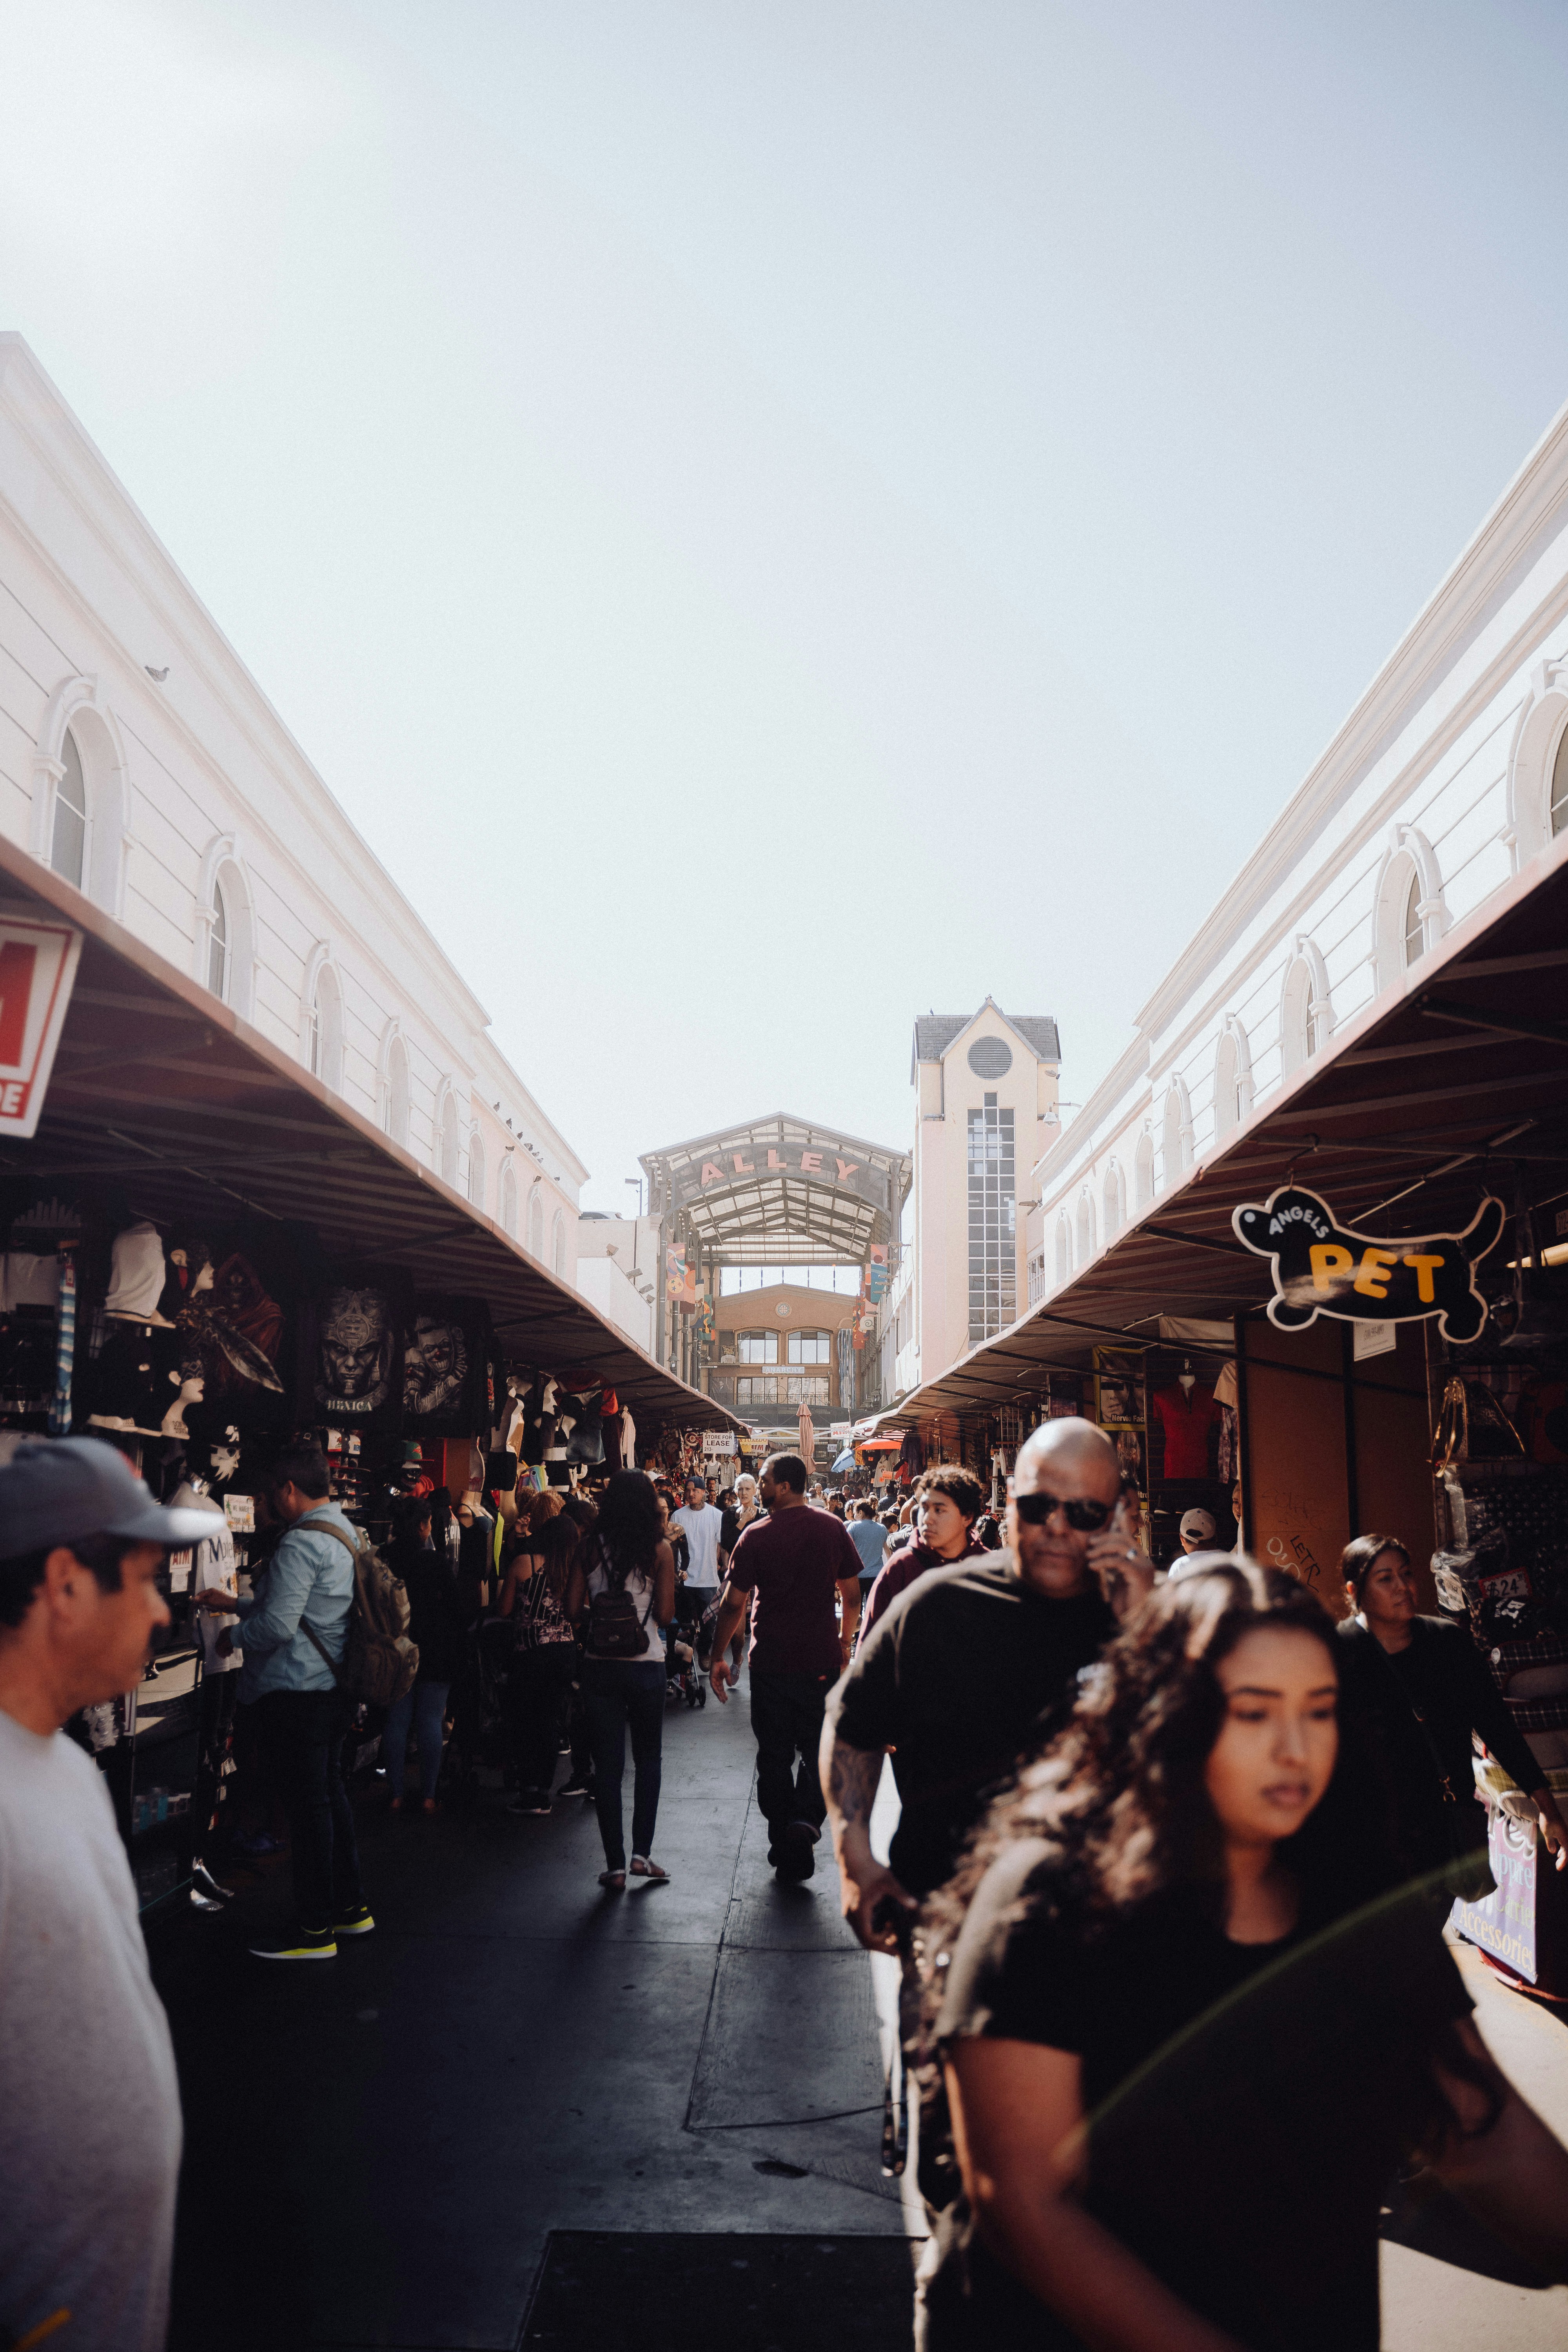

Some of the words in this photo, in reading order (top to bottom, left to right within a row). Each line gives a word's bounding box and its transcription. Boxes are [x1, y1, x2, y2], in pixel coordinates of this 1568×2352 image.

[701, 1149, 860, 1184] ALLEY
[1269, 1206, 1329, 1238] ANGELS
[1308, 1243, 1445, 1303] PET
[327, 1399, 373, 1411] MEXICA
[172, 1548, 190, 1565] ATM
[1458, 1901, 1534, 1973] Accessories
